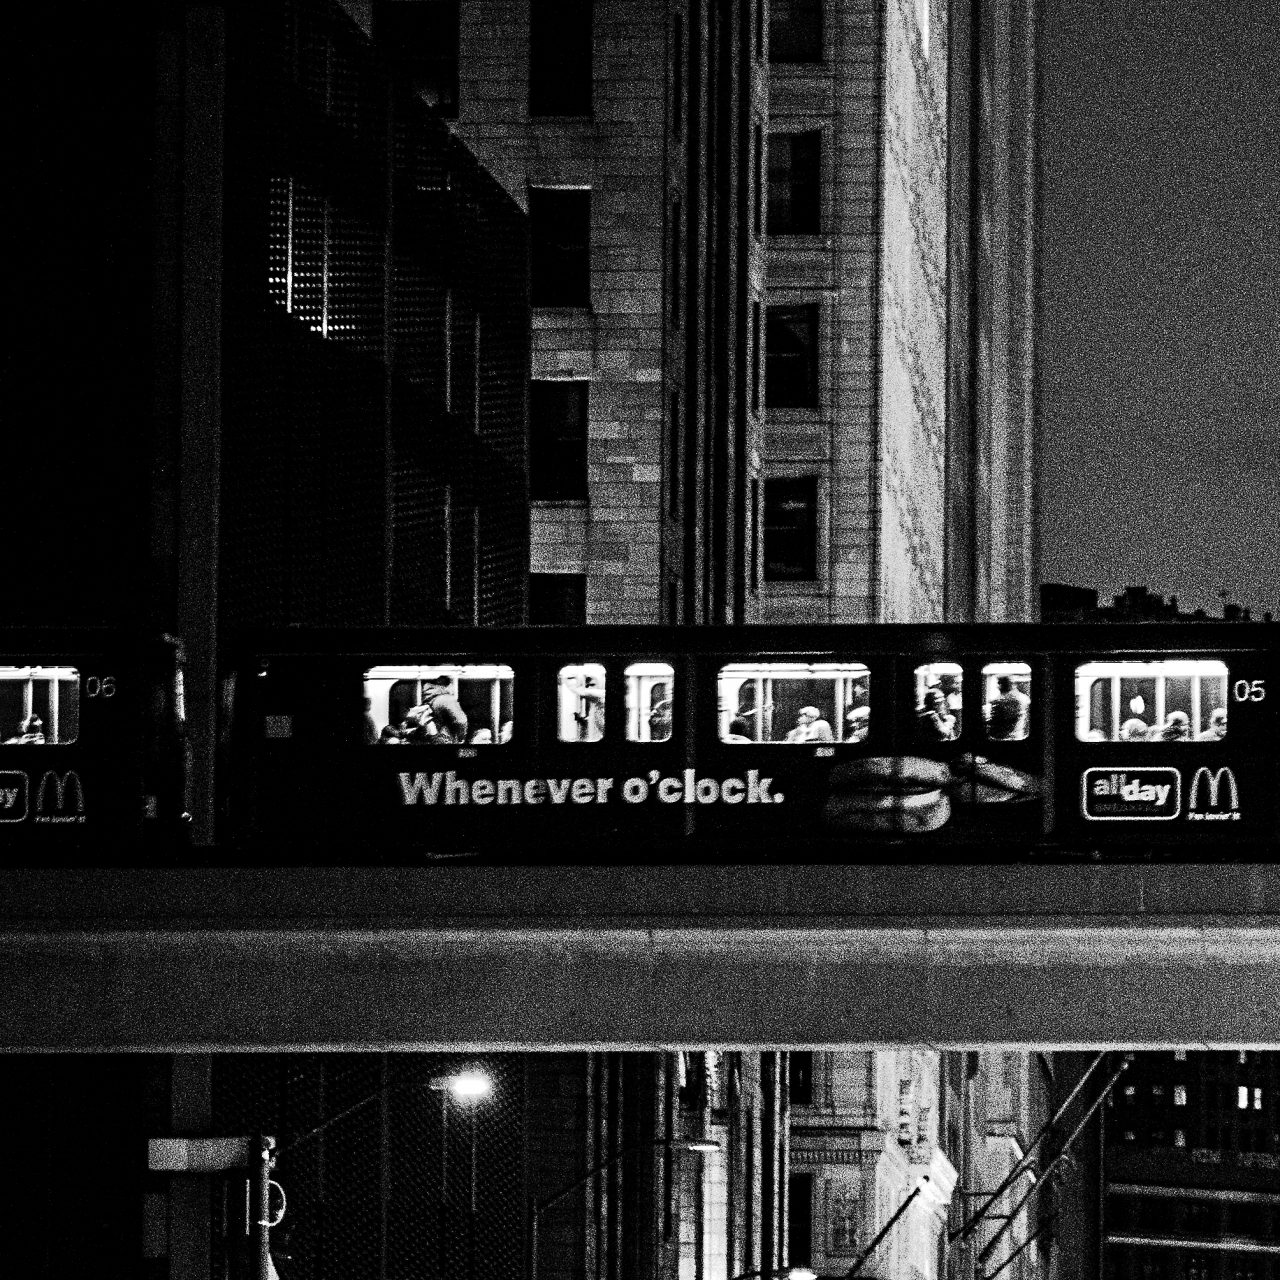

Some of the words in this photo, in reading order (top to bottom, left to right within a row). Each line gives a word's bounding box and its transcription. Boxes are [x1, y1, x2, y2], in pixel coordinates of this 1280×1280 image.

[86, 676, 116, 698] 06
[1233, 679, 1266, 702] 05
[398, 770, 614, 805] Whenever
[1093, 773, 1127, 796] all
[1121, 779, 1171, 806] day
